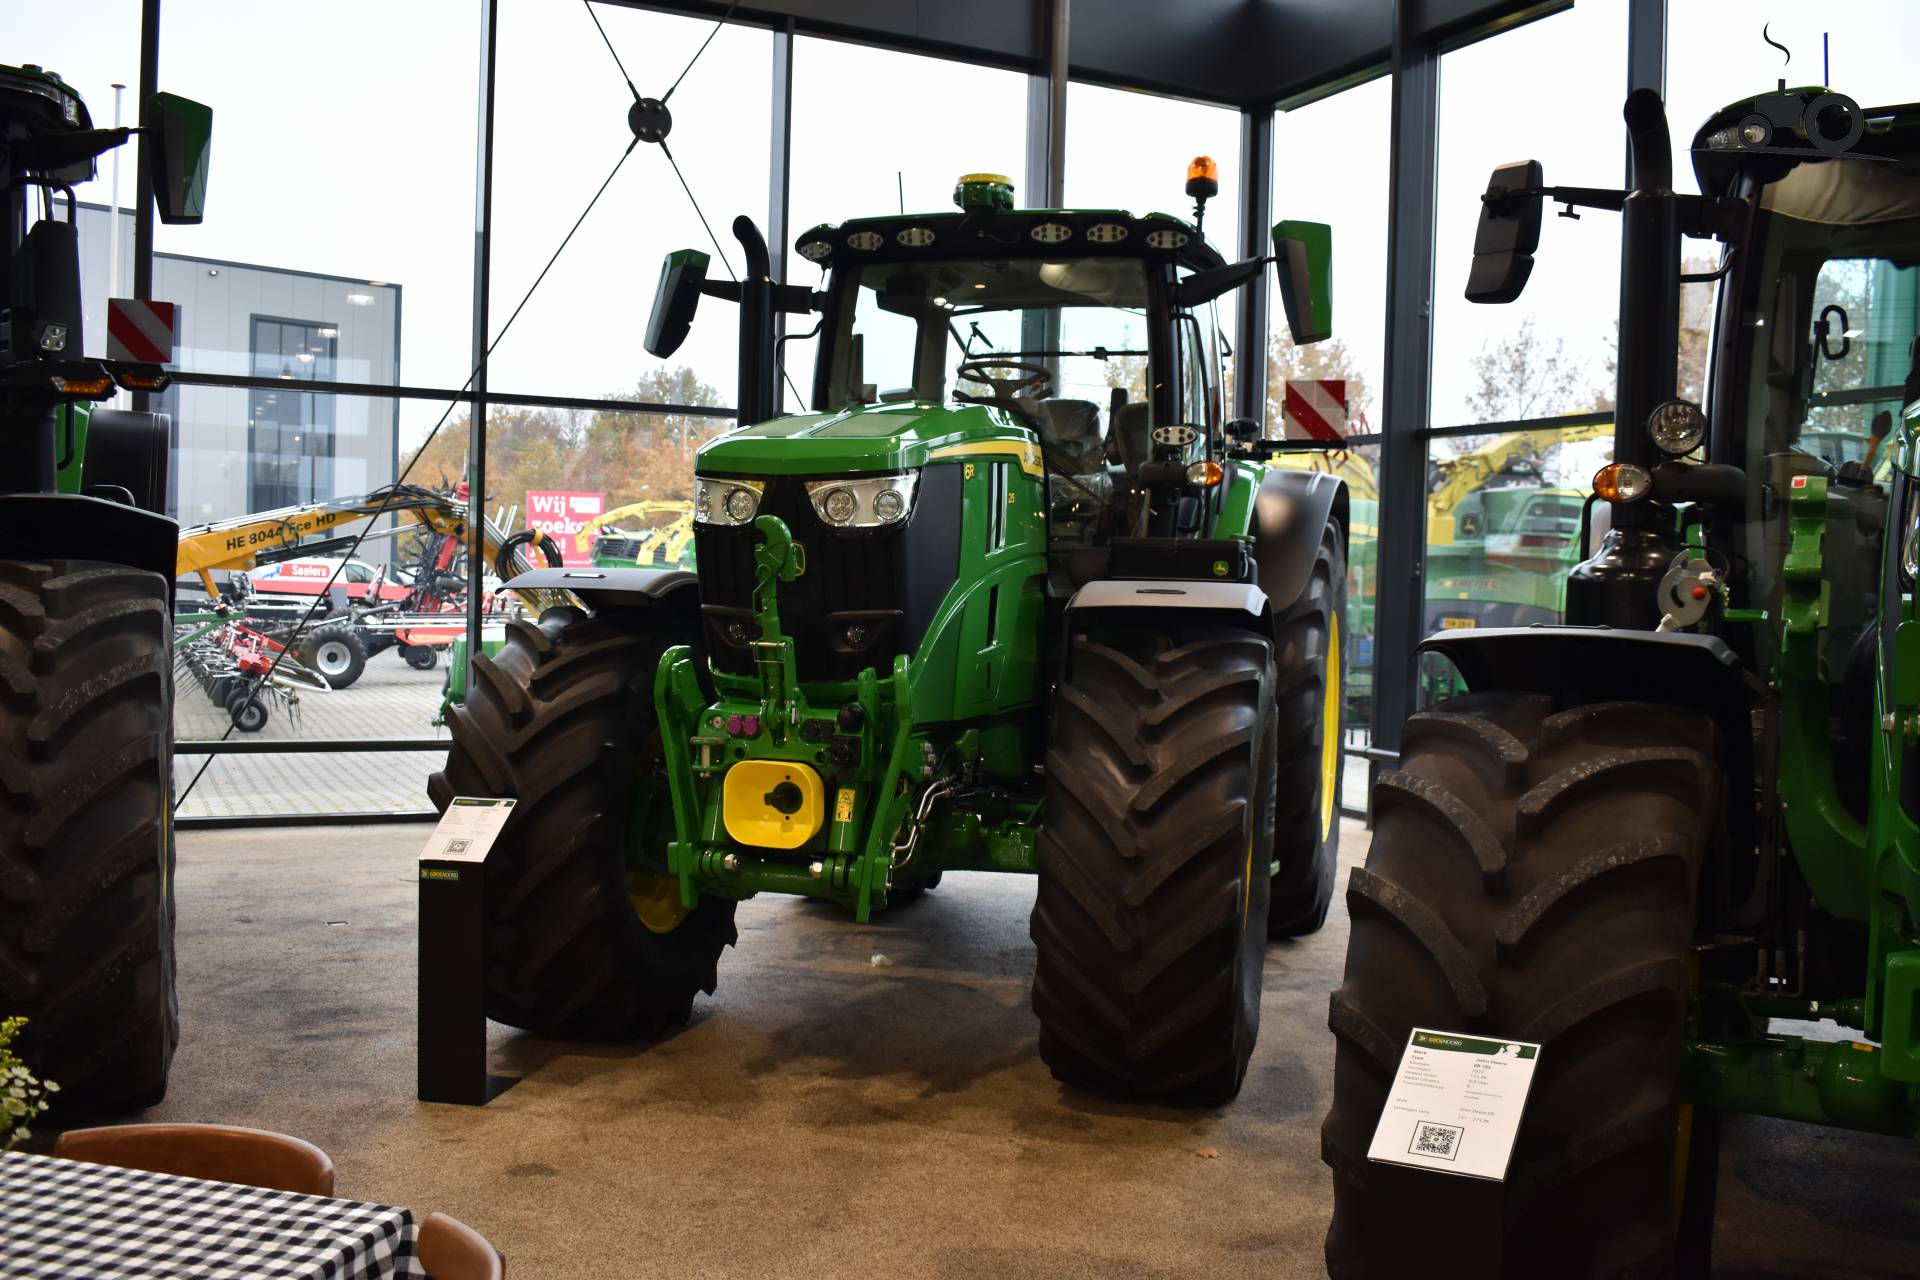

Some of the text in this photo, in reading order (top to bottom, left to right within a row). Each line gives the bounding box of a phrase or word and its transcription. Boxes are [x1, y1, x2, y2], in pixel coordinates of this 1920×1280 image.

[965, 463, 975, 480] 6R
[532, 496, 566, 517] Wij
[226, 536, 246, 551] HE
[249, 526, 283, 545] 8044
[316, 513, 337, 527] HD
